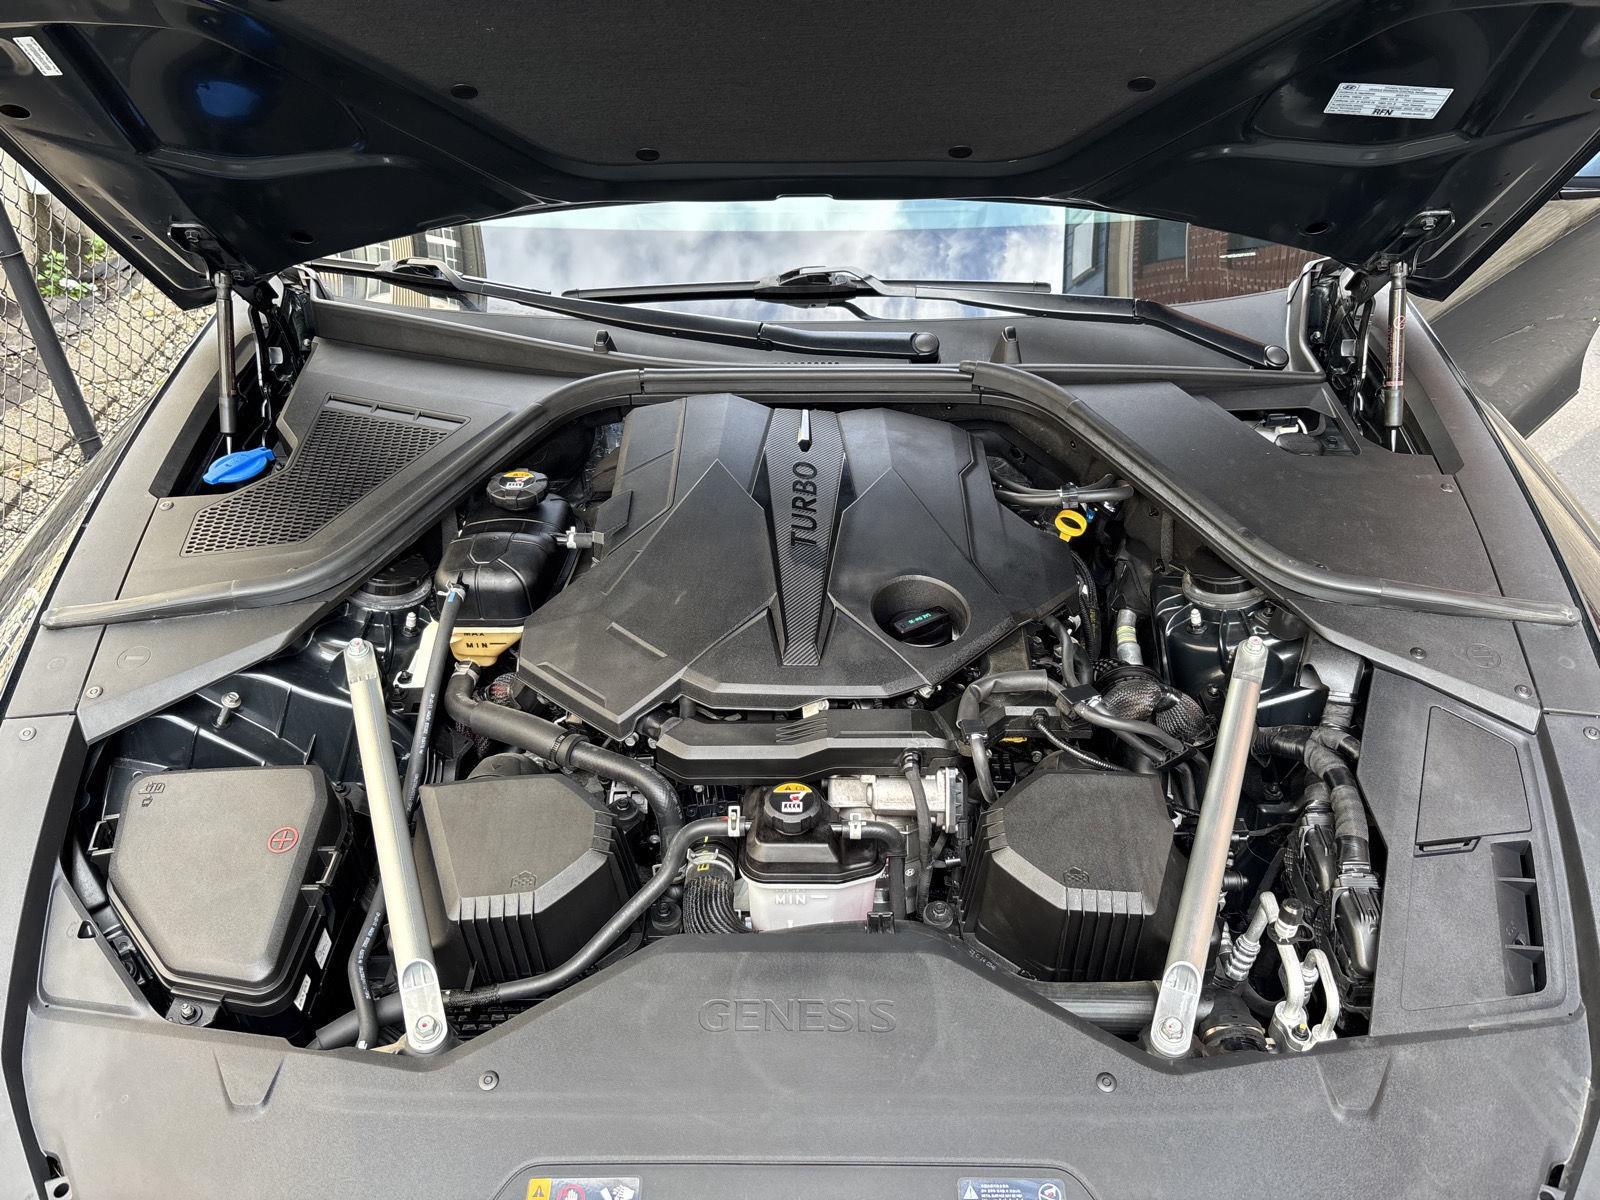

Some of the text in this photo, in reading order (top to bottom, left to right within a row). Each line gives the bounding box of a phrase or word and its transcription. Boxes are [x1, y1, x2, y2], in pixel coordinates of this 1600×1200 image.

[1371, 108, 1394, 117] RFN
[791, 462, 818, 546] TURBO
[775, 894, 806, 905] MIN
[698, 998, 896, 1033] GENESIS
